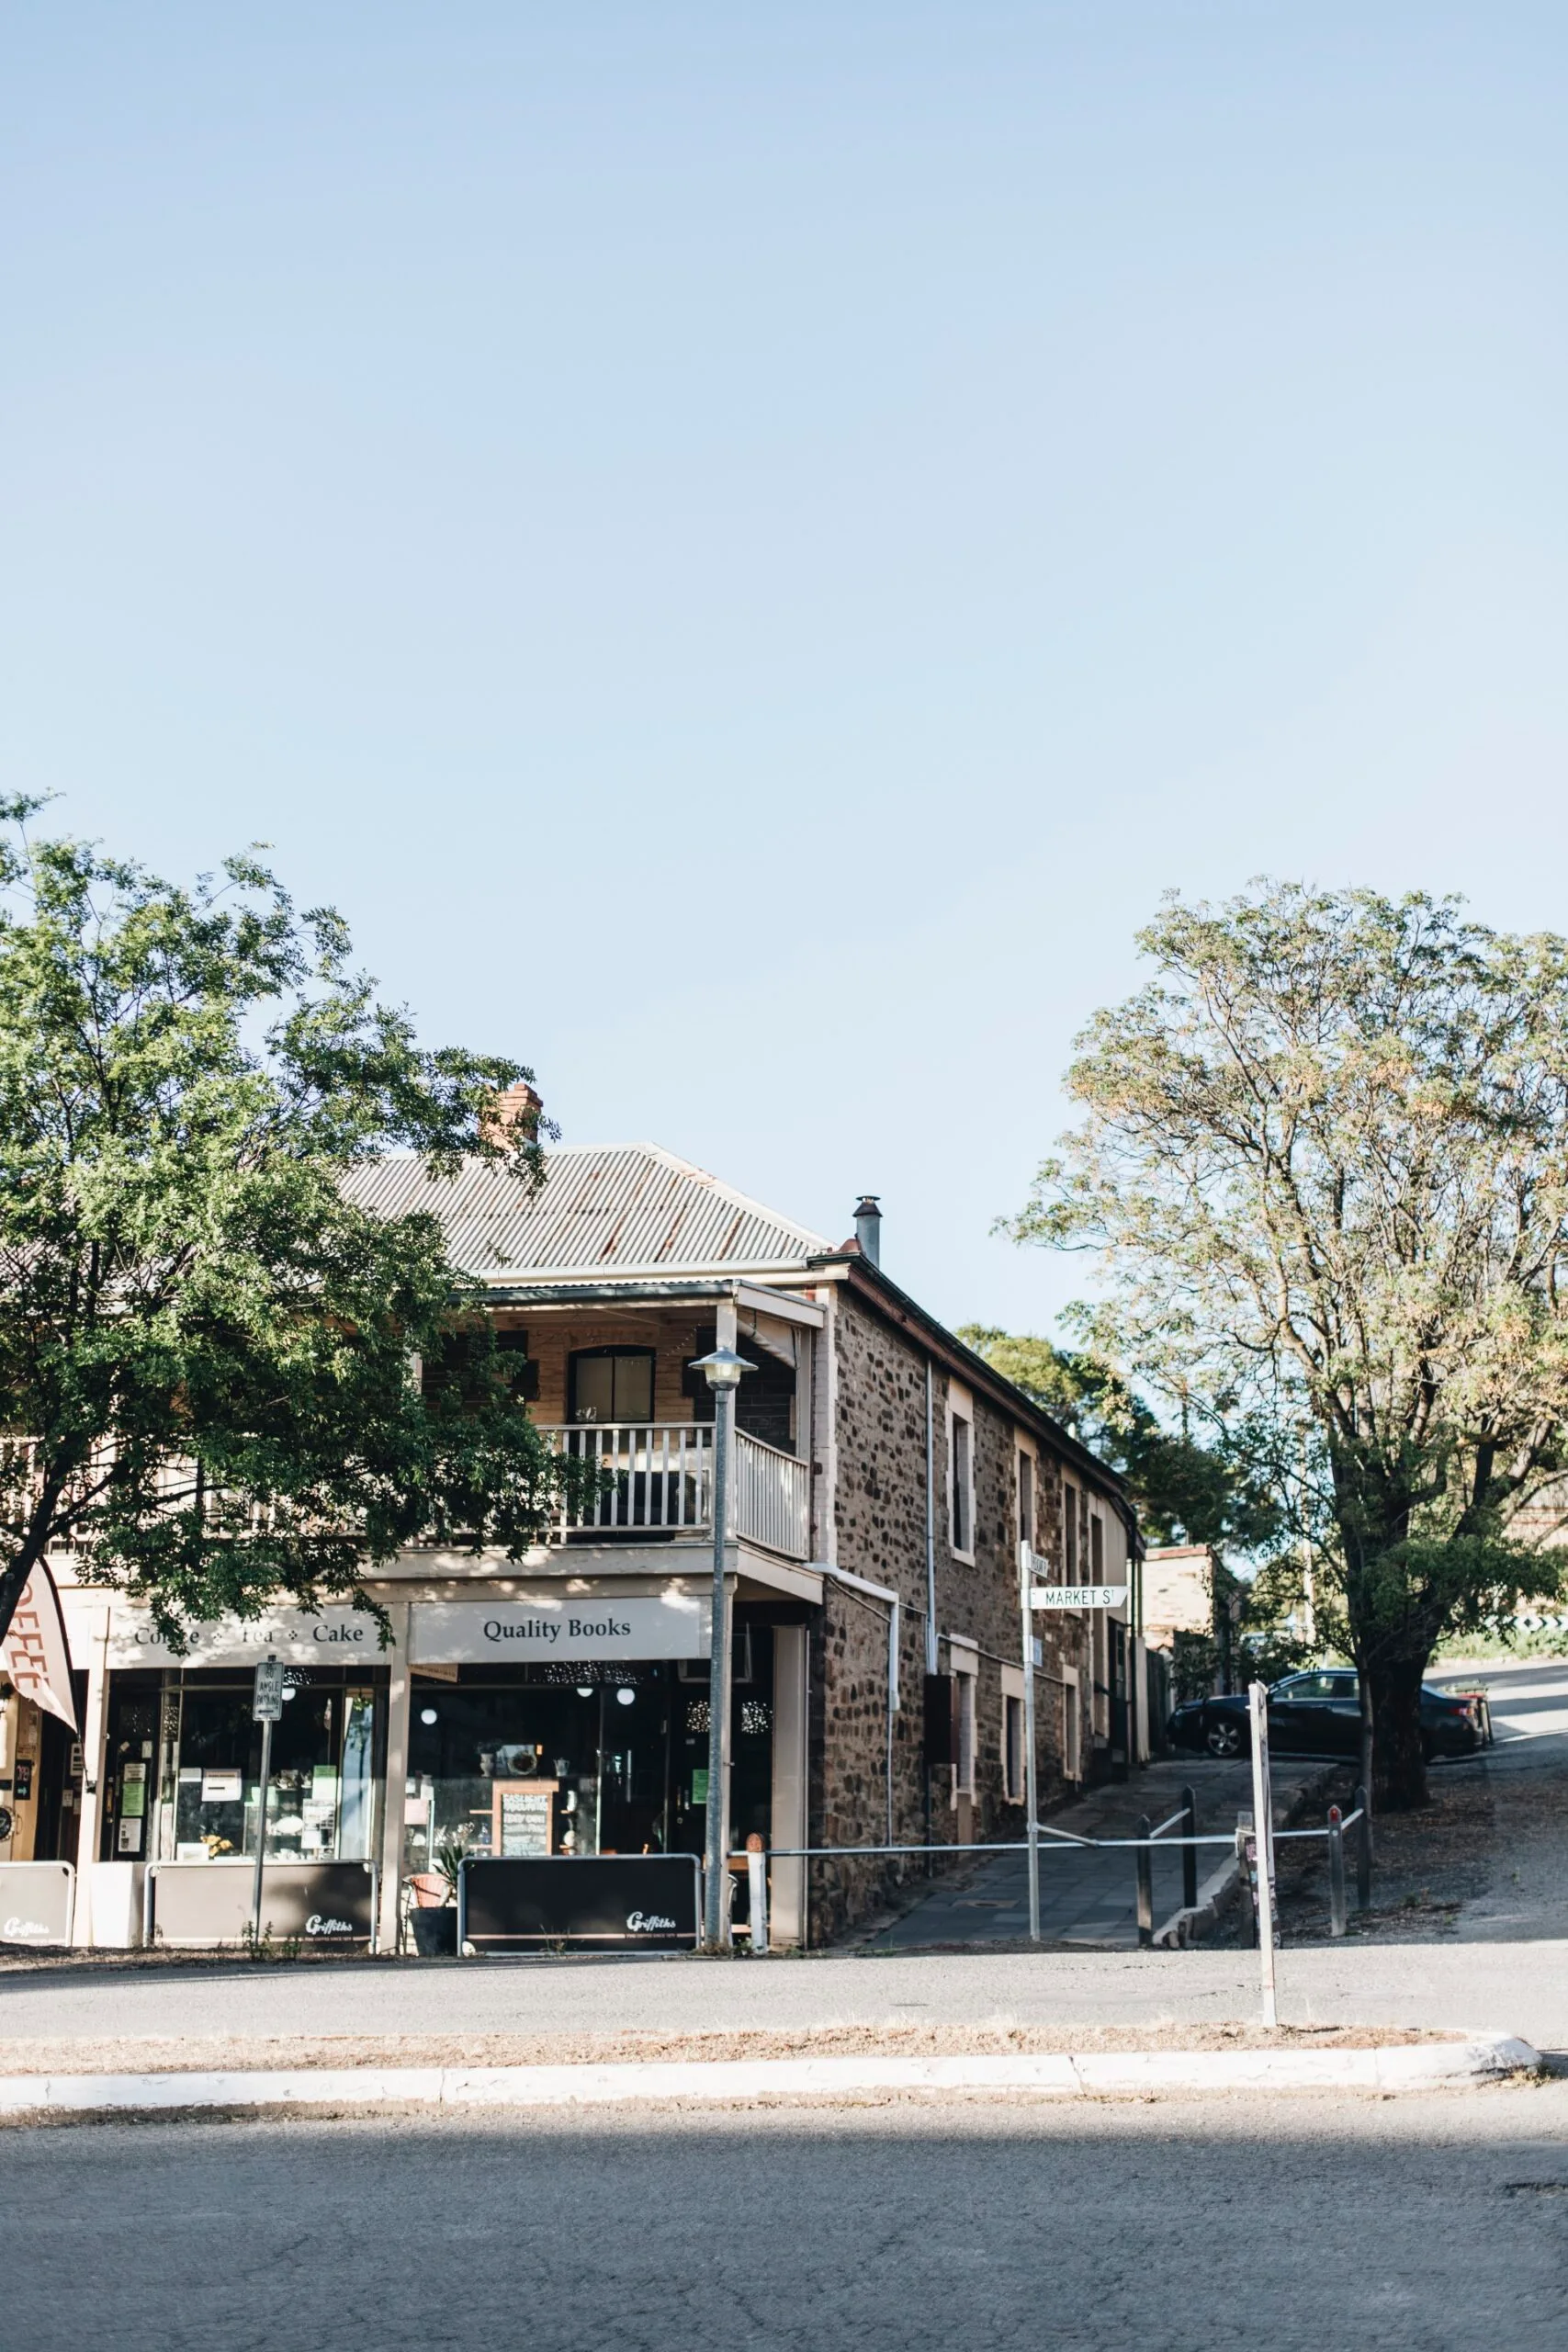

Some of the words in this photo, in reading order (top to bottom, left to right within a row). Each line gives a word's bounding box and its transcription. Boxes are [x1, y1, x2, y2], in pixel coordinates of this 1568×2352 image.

[1045, 1590, 1097, 1605] MARKET
[312, 1623, 364, 1643] Cake
[483, 1620, 561, 1644] Quality
[568, 1617, 631, 1637] Books
[259, 1680, 279, 1692] ANGLE
[305, 1915, 353, 1935] Griffiths
[626, 1911, 676, 1931] Griffiths
